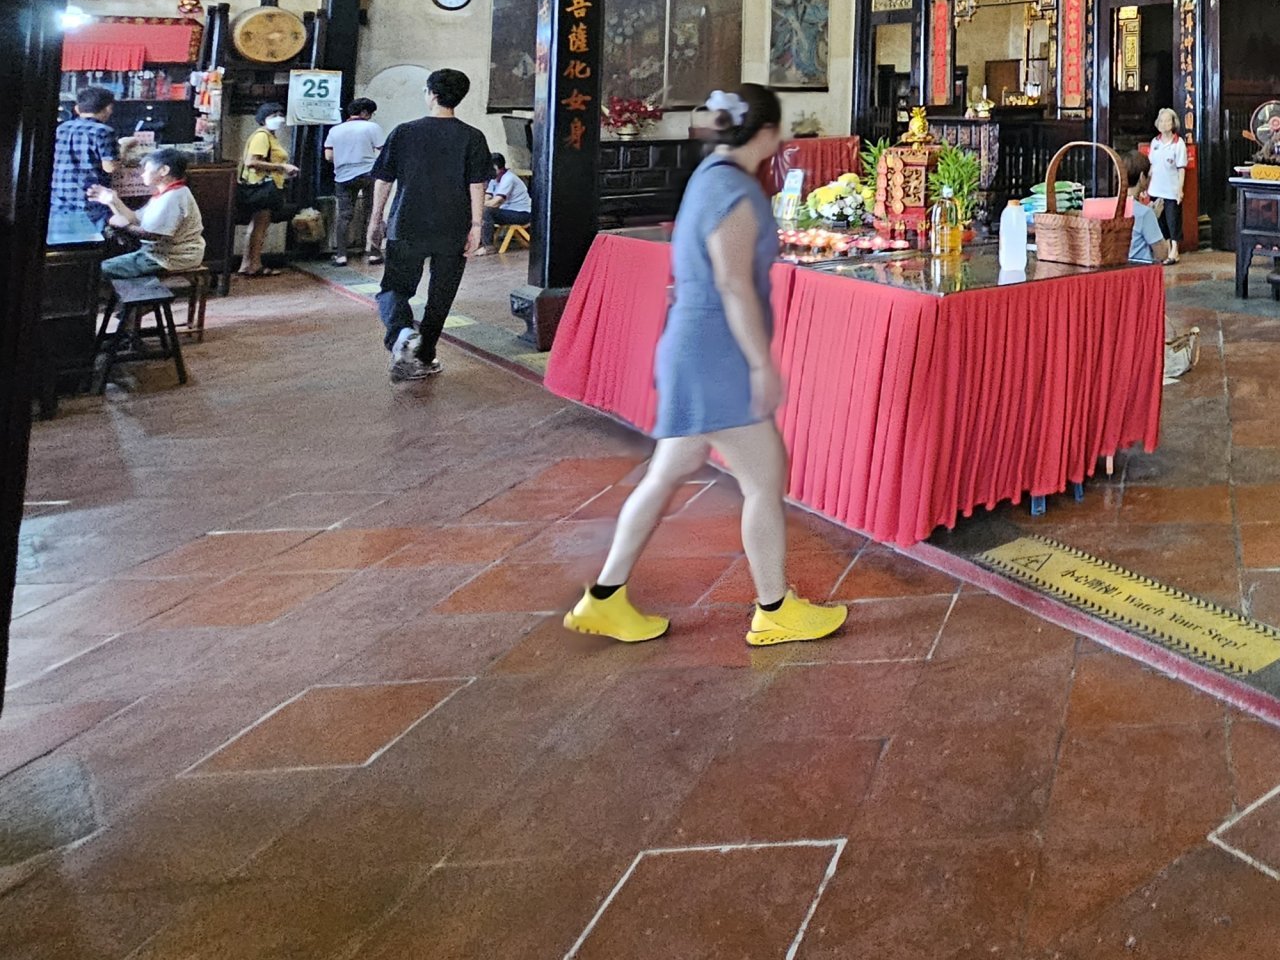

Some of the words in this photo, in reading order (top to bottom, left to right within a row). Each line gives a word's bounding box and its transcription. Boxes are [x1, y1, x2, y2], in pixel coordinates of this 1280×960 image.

[303, 79, 330, 98] 25
[1123, 594, 1165, 616] Watch
[1168, 612, 1203, 632] Your
[1202, 628, 1247, 650] Step!
